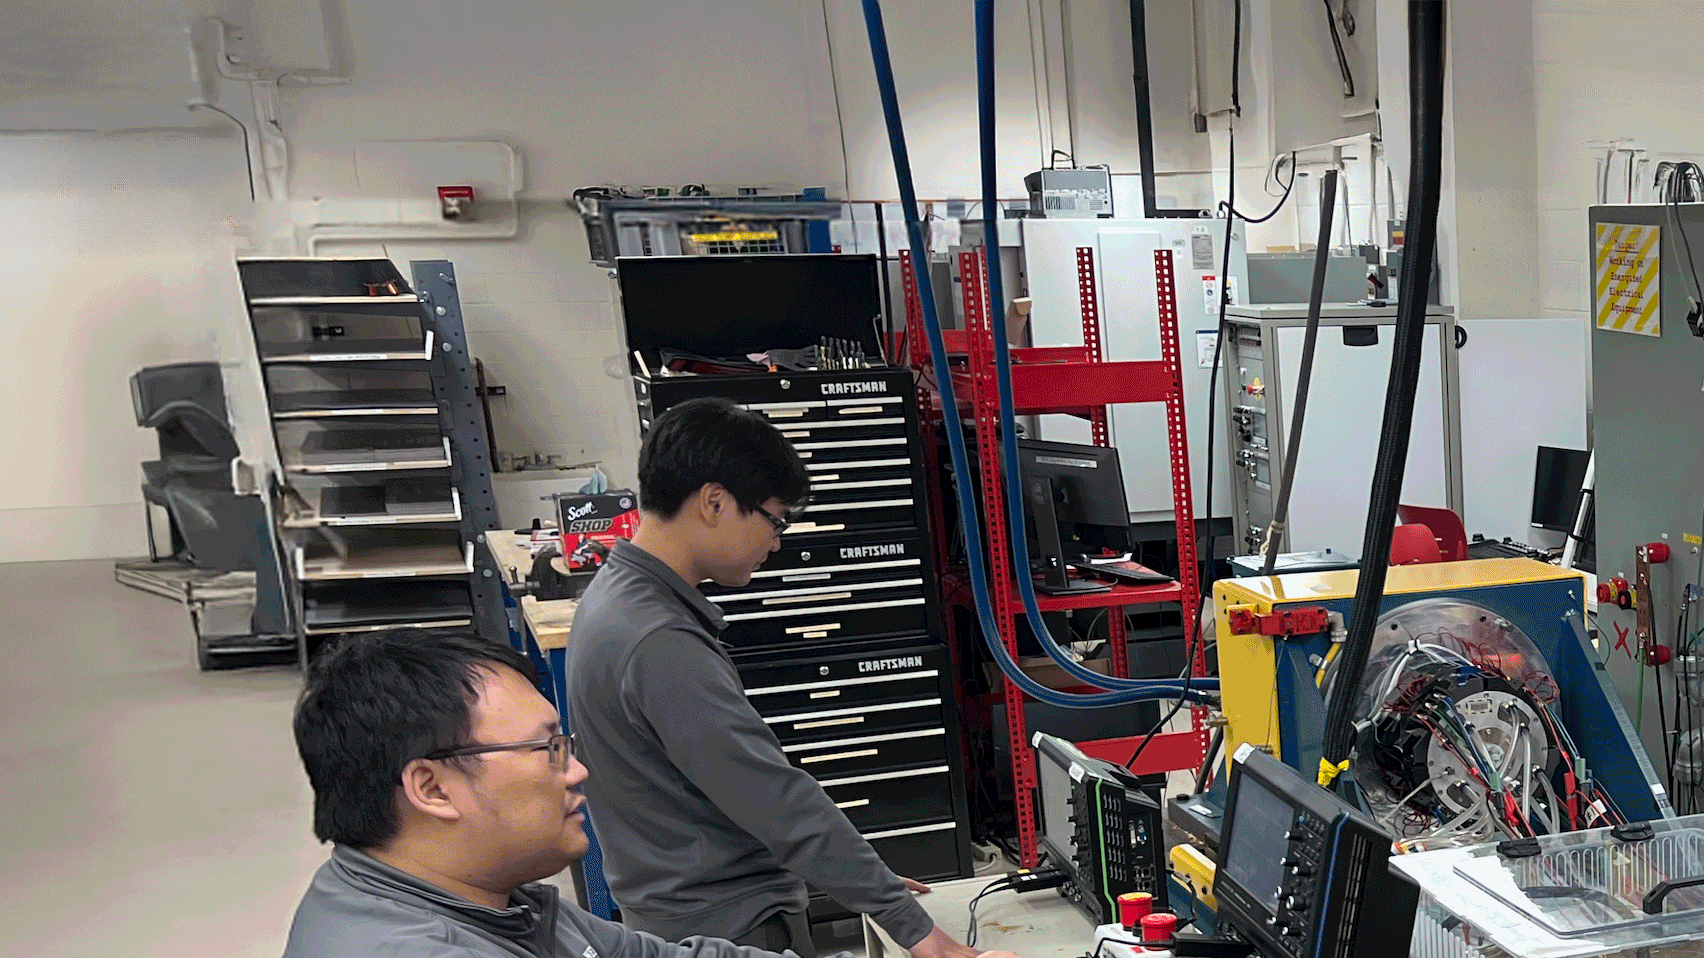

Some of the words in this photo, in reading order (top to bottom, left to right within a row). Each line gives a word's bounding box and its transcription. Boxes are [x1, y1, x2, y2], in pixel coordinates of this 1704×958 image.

[820, 381, 887, 395] CRAFTSMAN
[567, 501, 594, 521] Scott
[570, 518, 613, 534] SHOP
[840, 543, 905, 559] CRAFTSMAN
[858, 656, 923, 673] CRAFTSMAN
